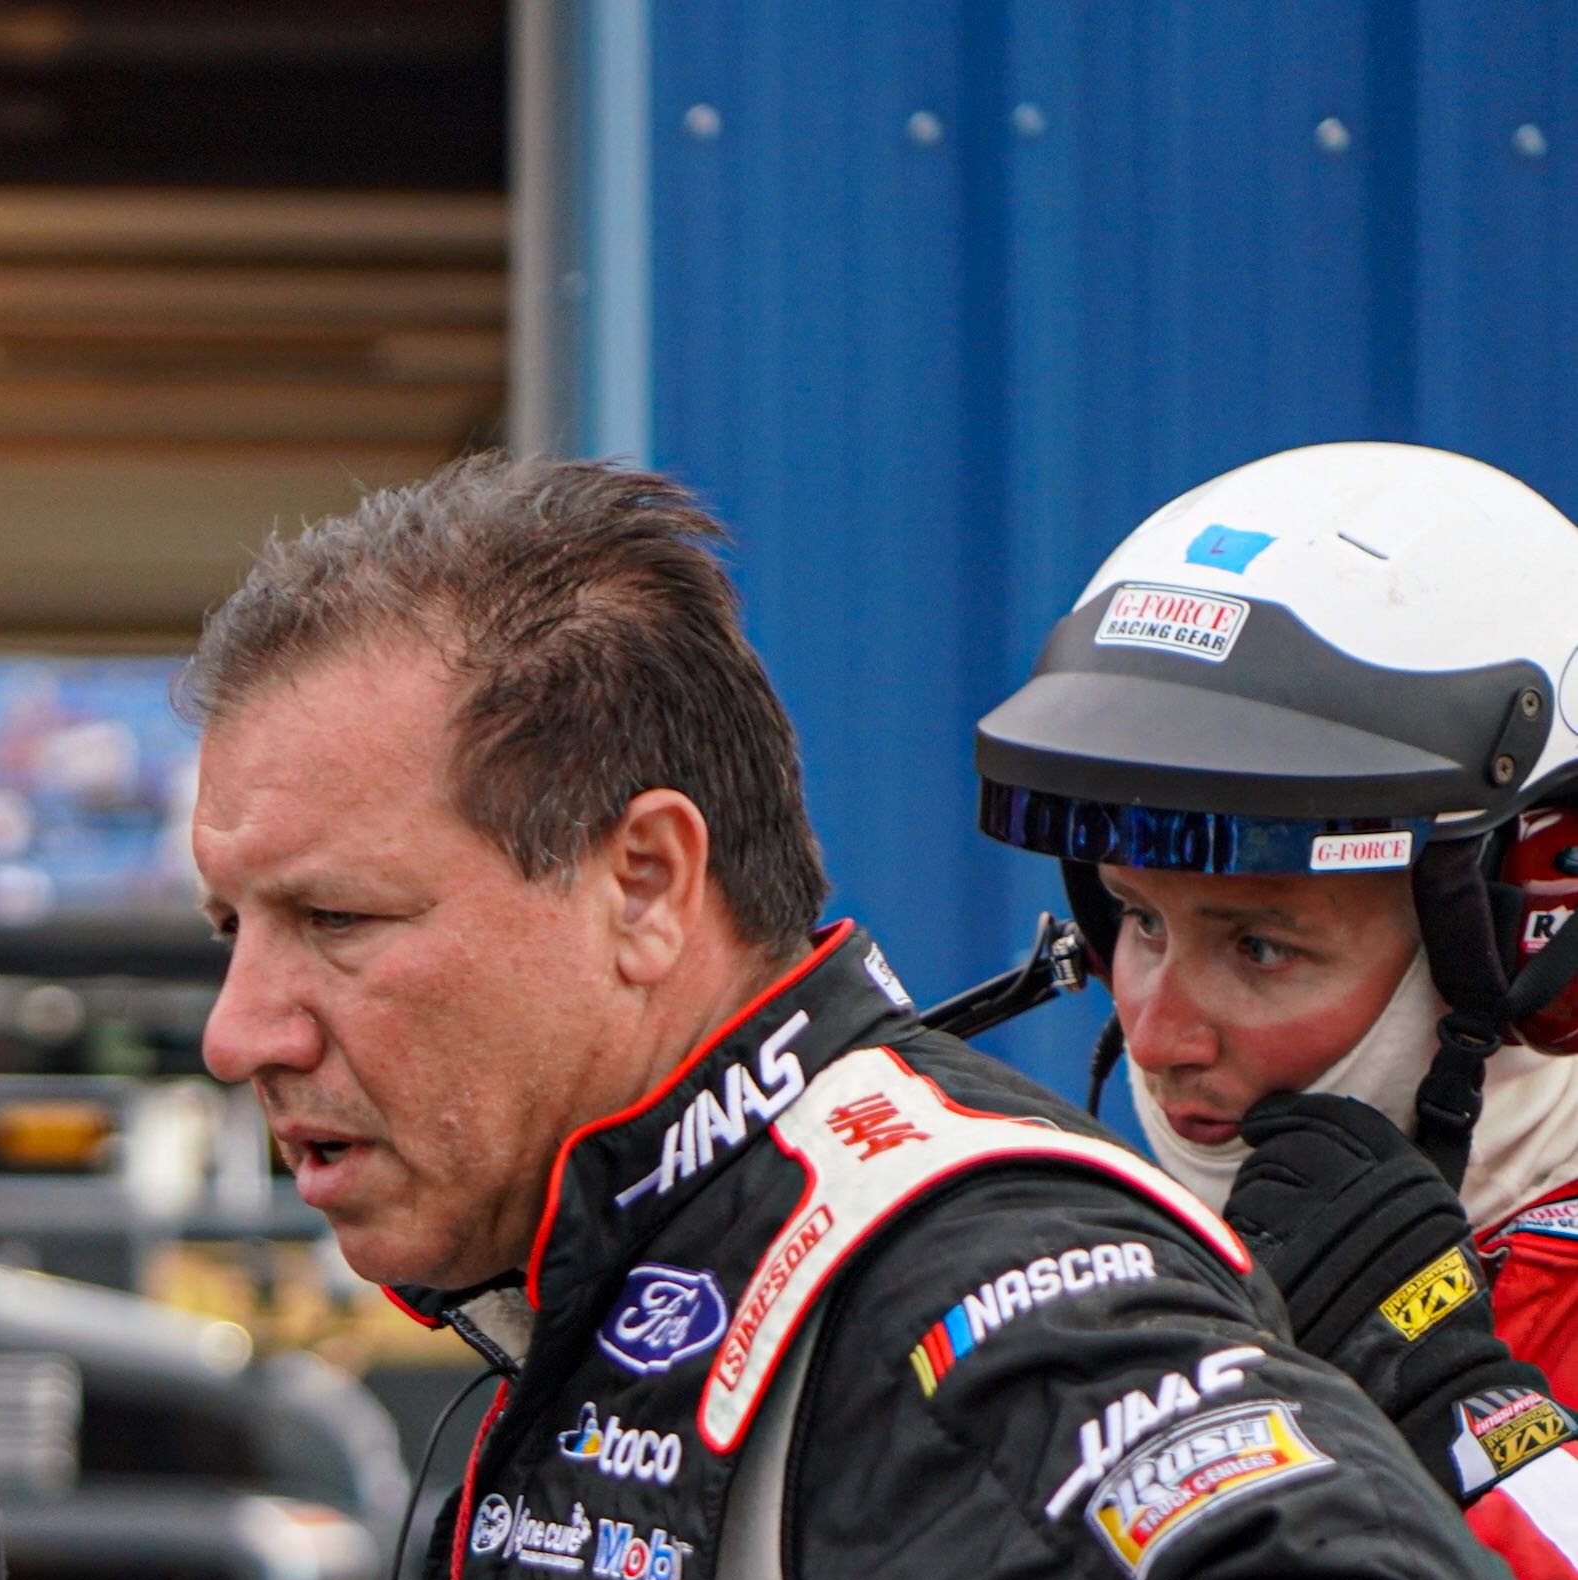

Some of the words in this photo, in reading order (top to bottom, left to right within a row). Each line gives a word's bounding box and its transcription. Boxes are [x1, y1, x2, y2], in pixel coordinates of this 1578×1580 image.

[1106, 620, 1172, 639] RACING
[1174, 627, 1227, 651] GEAR
[1115, 593, 1236, 633] G-FORCE
[1316, 838, 1408, 862] G-FORCE
[614, 1009, 811, 1206] HAAS
[614, 1280, 700, 1349] Ford
[725, 1220, 824, 1377] SIMPSON
[961, 1241, 1158, 1343] NASCAR
[600, 1414, 682, 1484] toco
[1114, 1416, 1277, 1526] RUSH
